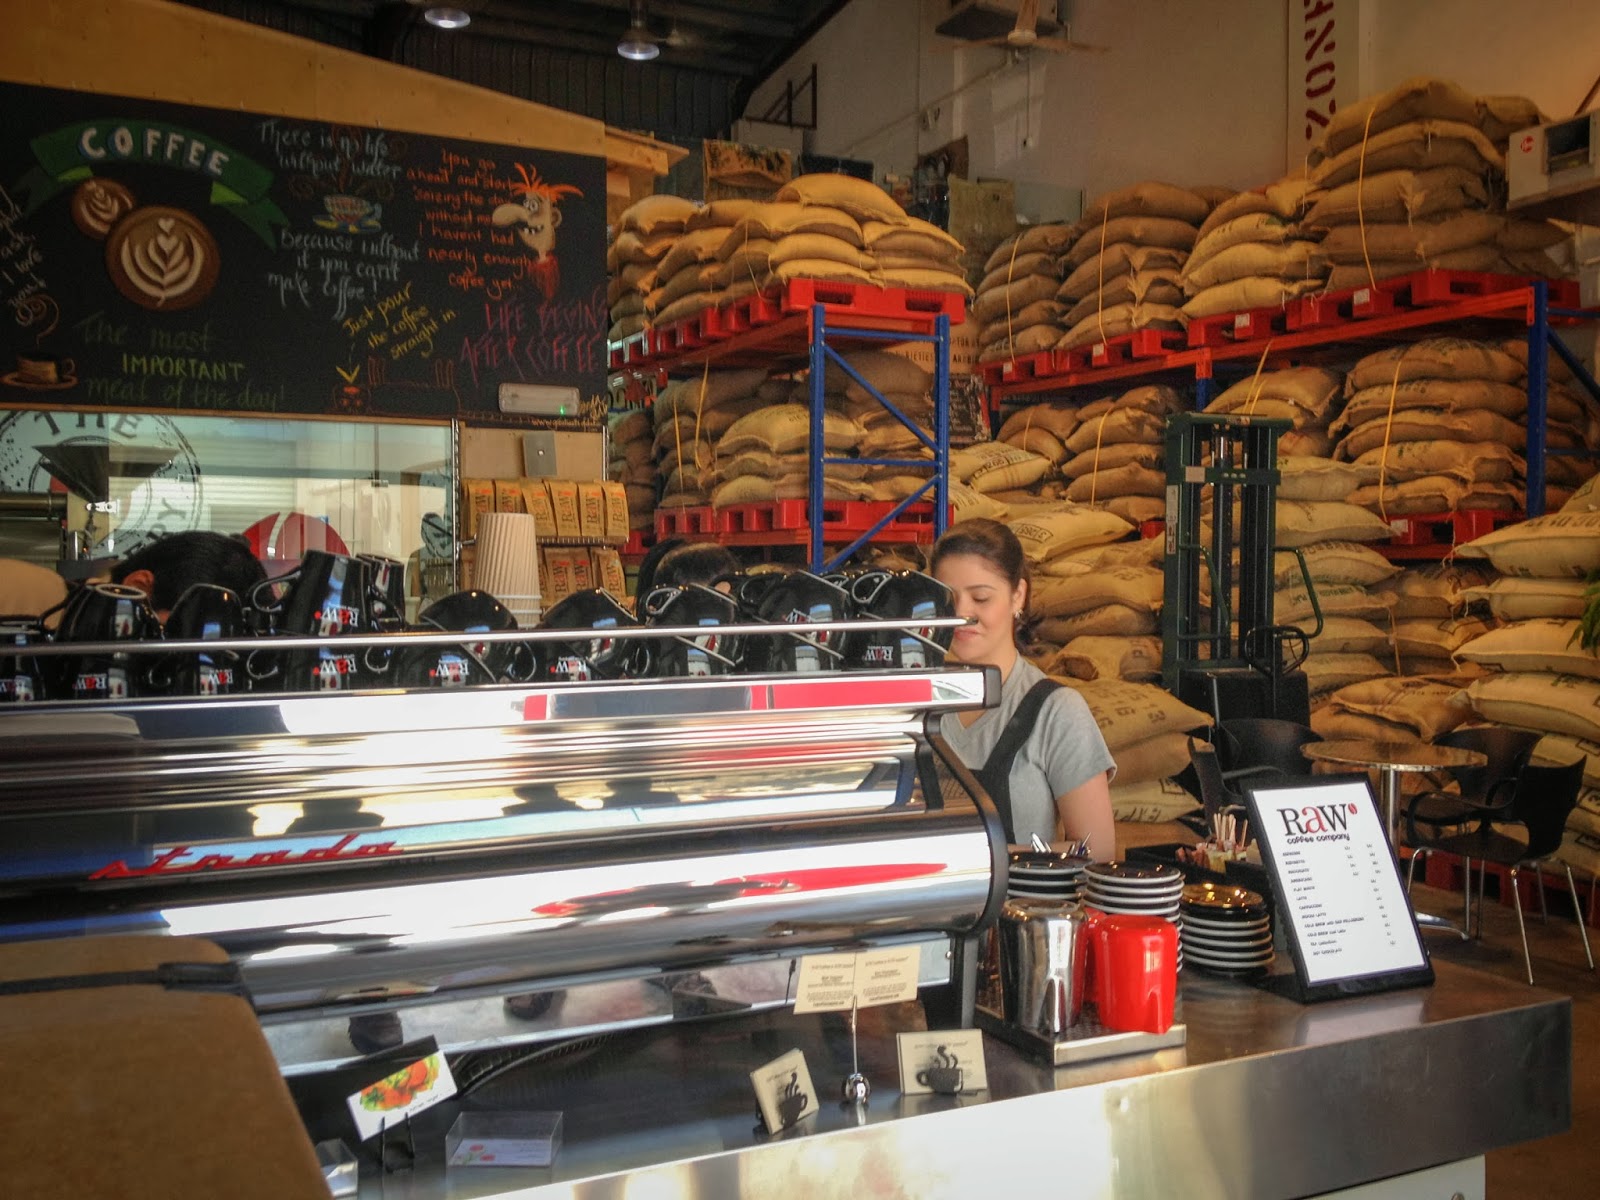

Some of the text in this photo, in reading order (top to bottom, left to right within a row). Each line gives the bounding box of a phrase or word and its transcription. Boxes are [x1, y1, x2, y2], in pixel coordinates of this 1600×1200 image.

[80, 127, 230, 176] COFFEE
[121, 351, 246, 383] IMPORTANT
[1287, 834, 1350, 845] coffee company
